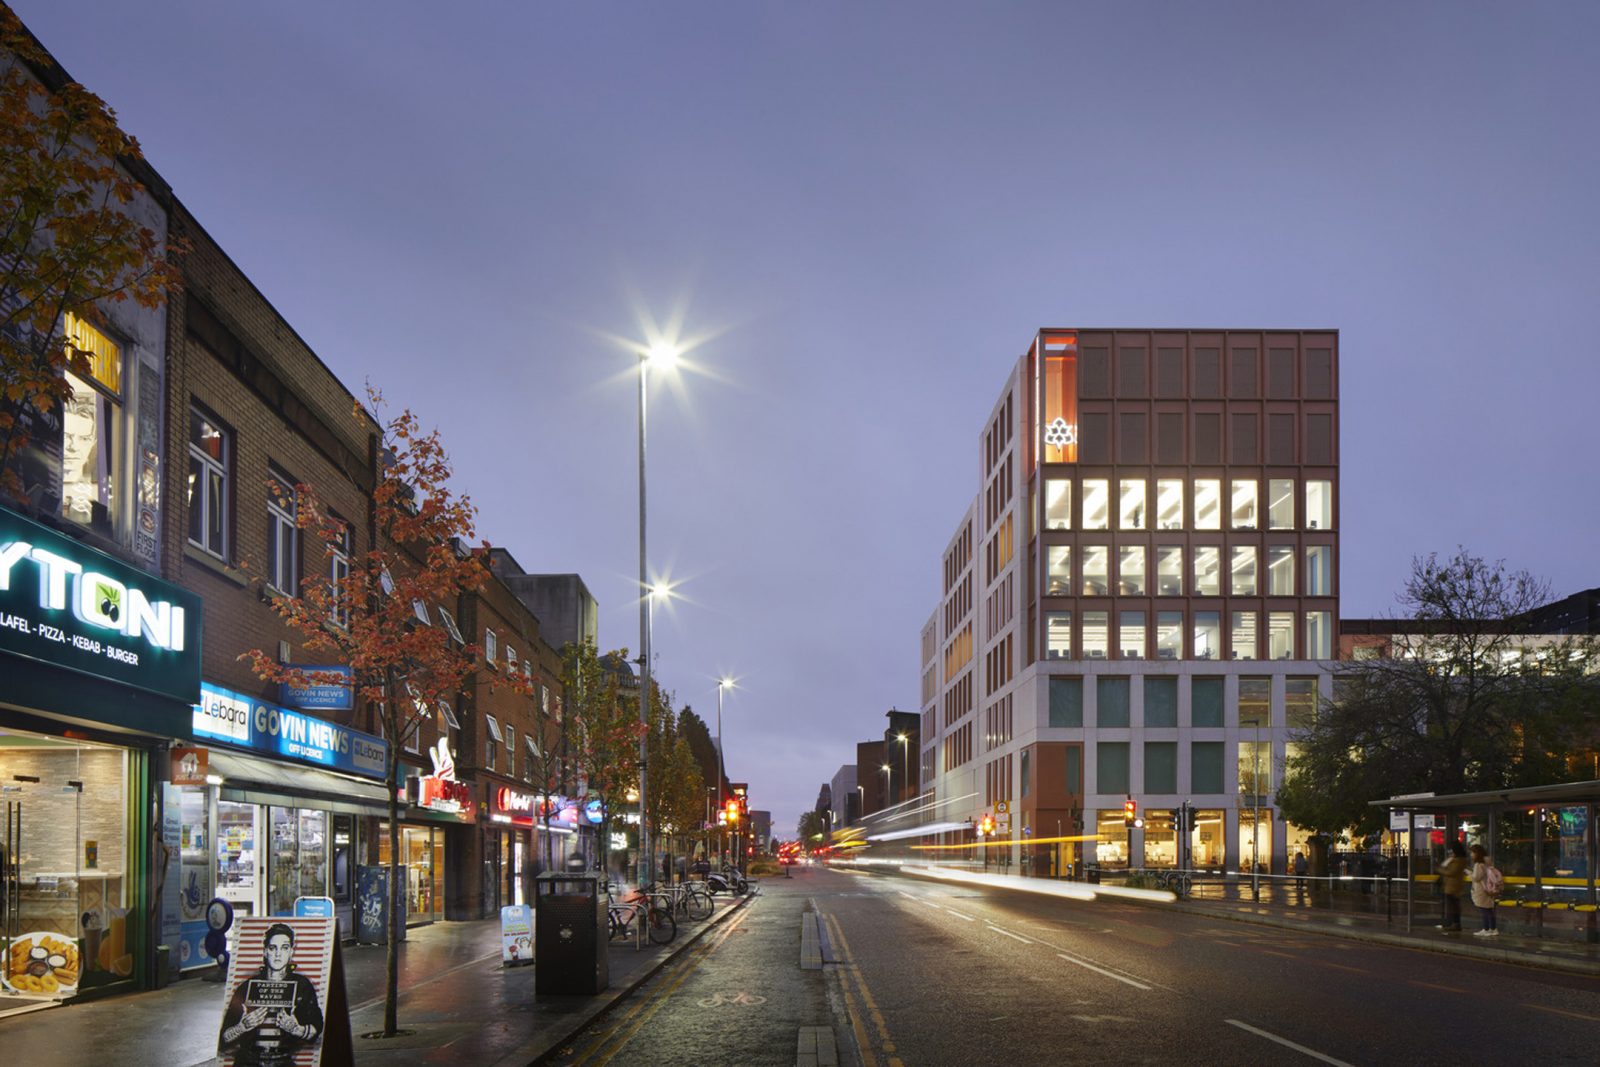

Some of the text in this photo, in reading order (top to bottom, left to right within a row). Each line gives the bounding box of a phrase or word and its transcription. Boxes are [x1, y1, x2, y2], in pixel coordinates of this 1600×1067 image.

[137, 531, 158, 549] FIRST
[39, 624, 66, 643] PIZZA
[73, 635, 101, 654] KEBAB
[107, 645, 139, 666] BURGER
[288, 689, 344, 698] GOVIN NEWS
[204, 696, 246, 725] Lebara
[255, 706, 349, 754] GOVIN NEWS
[289, 743, 323, 760] OFF LICENCE
[360, 741, 384, 762] Lebara
